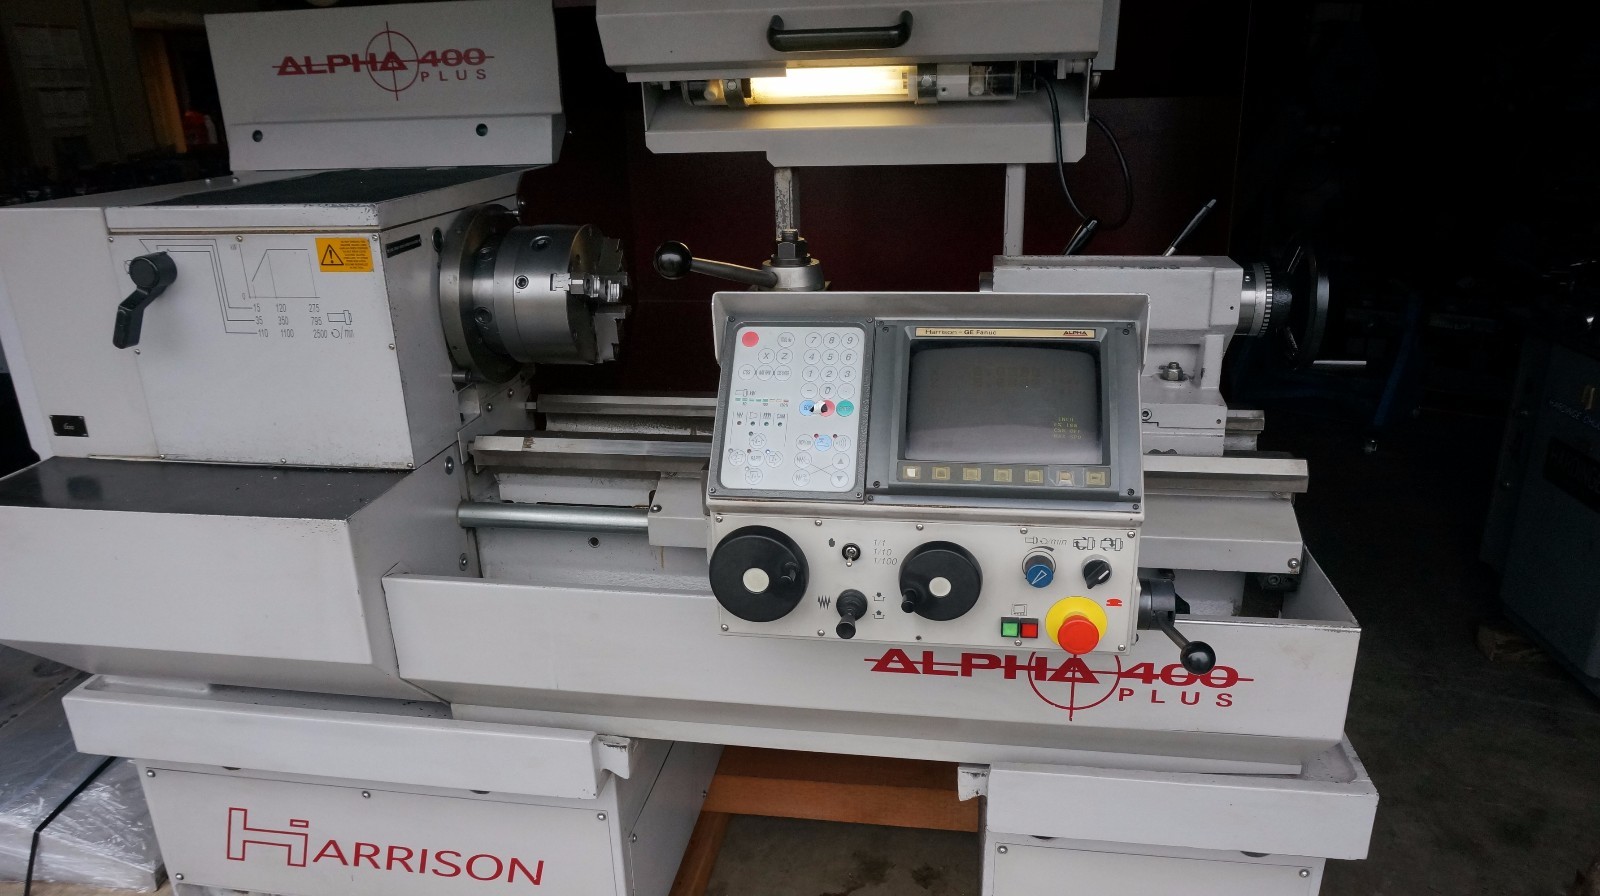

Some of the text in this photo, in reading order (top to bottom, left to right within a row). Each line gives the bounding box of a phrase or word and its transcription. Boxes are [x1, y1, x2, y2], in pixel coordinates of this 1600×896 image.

[276, 47, 487, 76] ALPHA 400
[420, 69, 487, 82] PLUS
[253, 303, 320, 313] 15 120 275
[255, 315, 323, 326] 35 350 795
[258, 328, 269, 338] 110
[280, 328, 295, 338] 1100
[313, 329, 328, 339] 2500
[828, 336, 835, 344] 8
[846, 337, 853, 345] 9
[762, 352, 789, 360] X Z
[845, 353, 852, 361] 6
[844, 370, 851, 378] 3
[824, 386, 831, 395] 0
[873, 548, 892, 556] 1/10
[873, 557, 898, 565] 1/100
[870, 648, 1239, 689] ALPHA 400
[1118, 687, 1233, 707] PLUS
[227, 807, 544, 886] HARRISON
